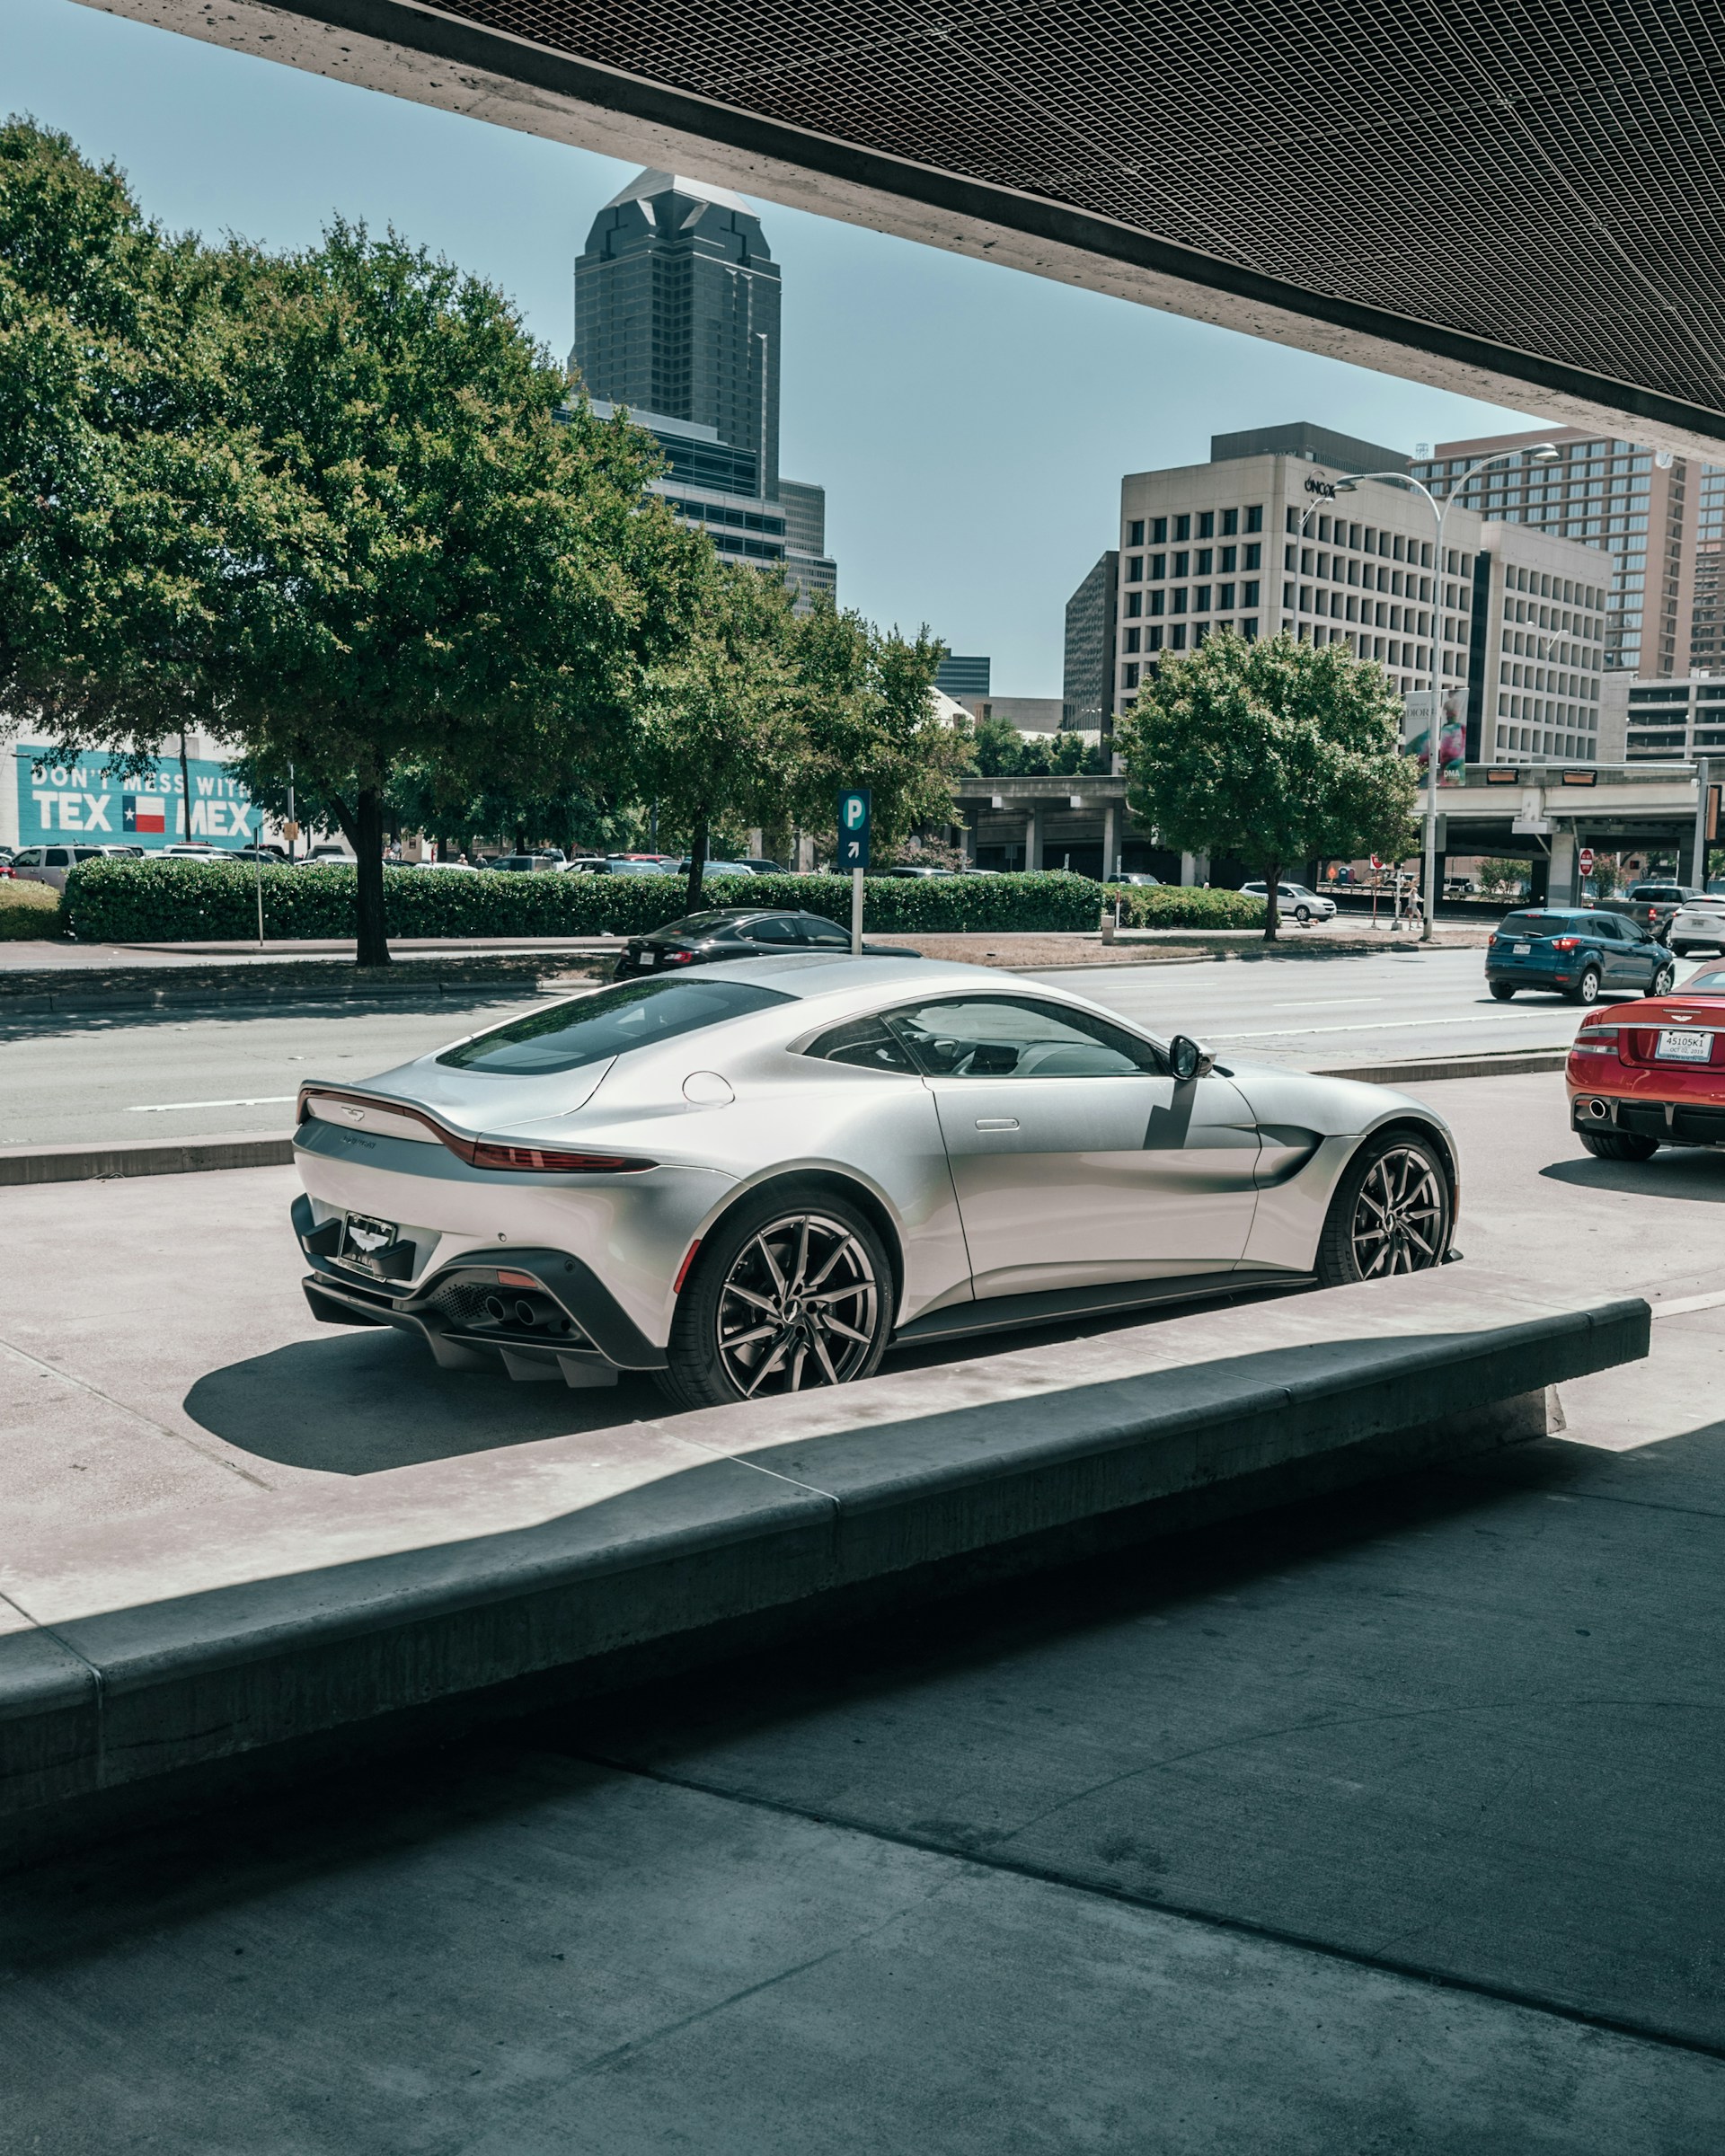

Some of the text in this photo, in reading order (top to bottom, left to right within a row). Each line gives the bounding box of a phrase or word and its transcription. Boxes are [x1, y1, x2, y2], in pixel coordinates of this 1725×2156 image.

[123, 771, 185, 794] MESS
[1444, 770, 1460, 778] DMA
[32, 790, 252, 837] TEX MEX
[847, 800, 862, 827] P
[1667, 1038, 1703, 1047] 45105K1
